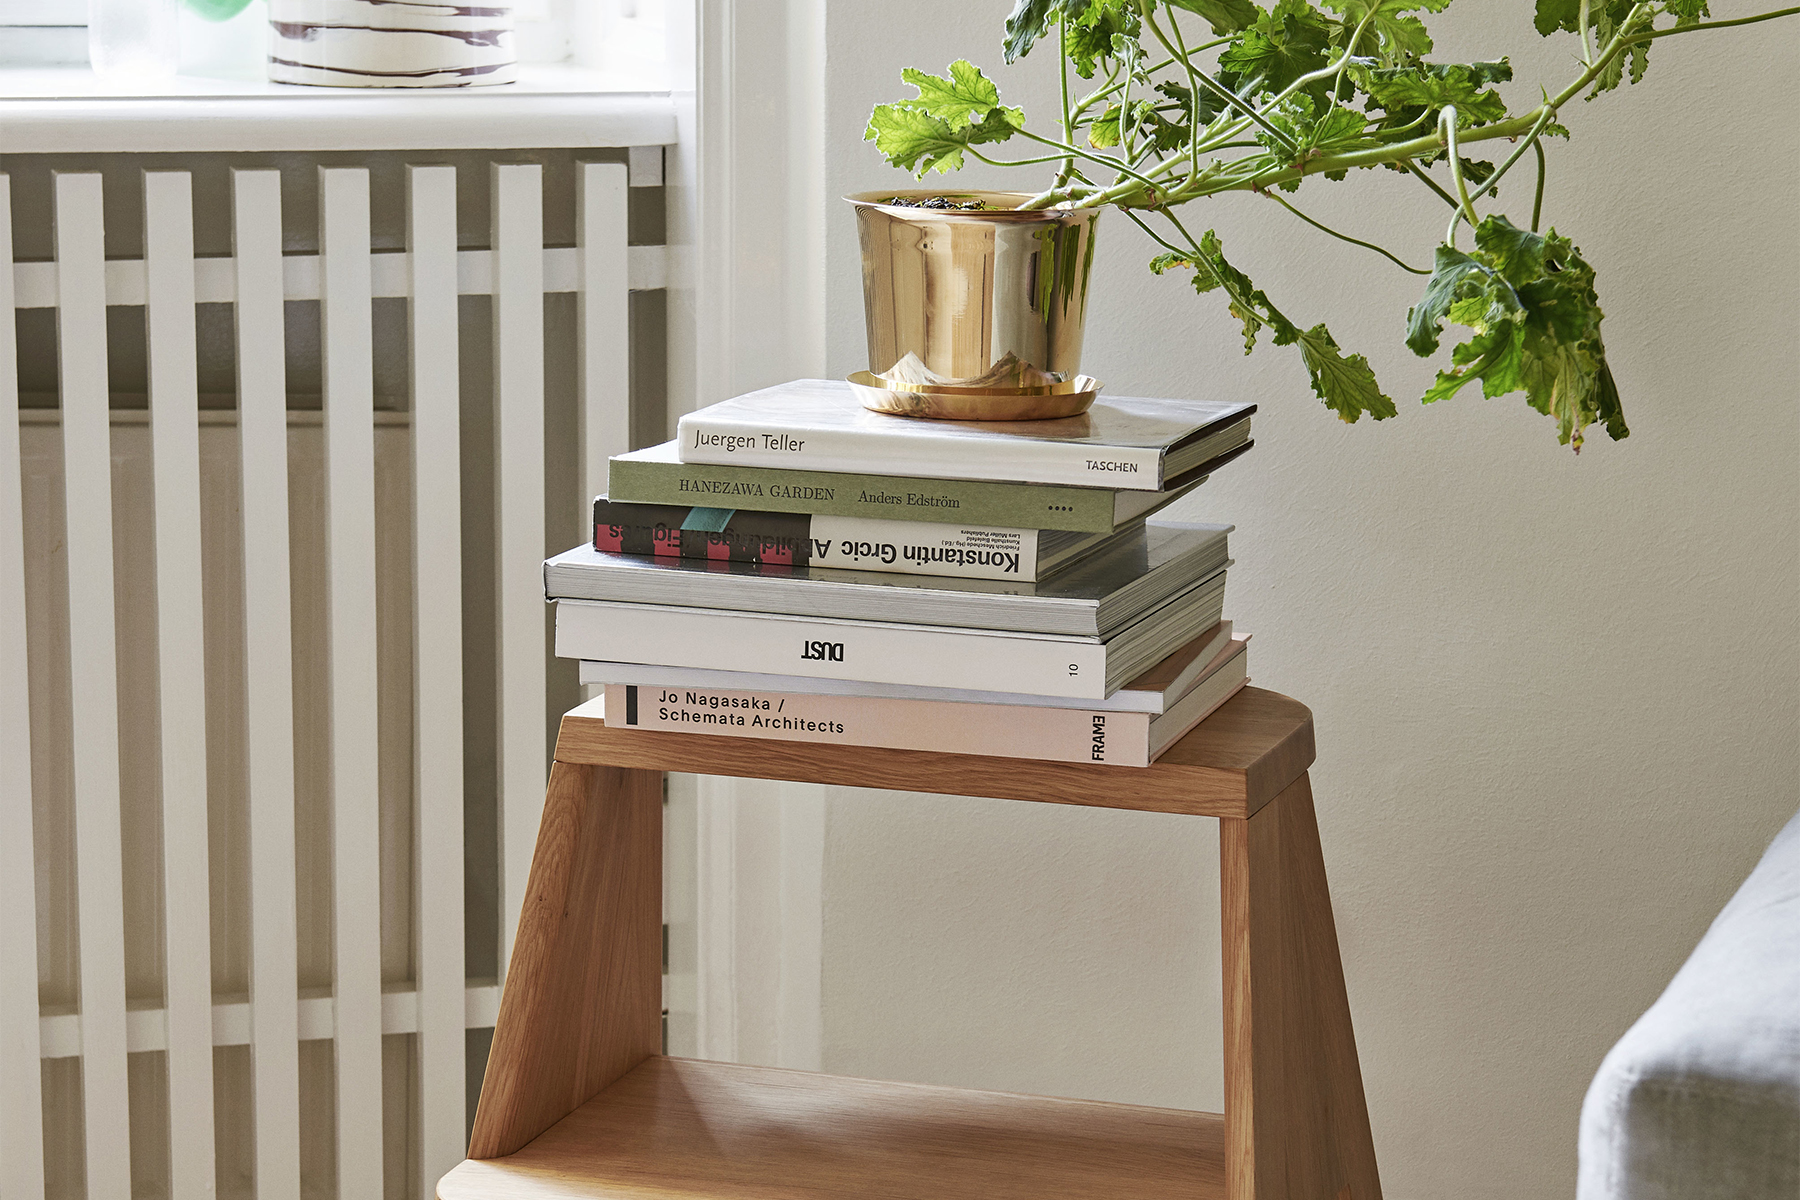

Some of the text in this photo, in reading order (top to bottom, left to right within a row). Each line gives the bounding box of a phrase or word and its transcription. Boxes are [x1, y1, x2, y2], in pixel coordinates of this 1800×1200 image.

[694, 429, 805, 452] Juergen Teller
[1085, 459, 1139, 474] TASCHEN
[679, 479, 836, 501] HANEZAWA GARDEN
[858, 490, 961, 509] Anders Edström
[841, 540, 897, 564] Grcic
[903, 544, 1020, 574] Konstantin
[801, 640, 844, 662] DUST
[1068, 663, 1079, 677] 10
[658, 689, 679, 704] Jo
[685, 691, 771, 711] Nagasaka
[658, 707, 845, 734] Schemata Architects
